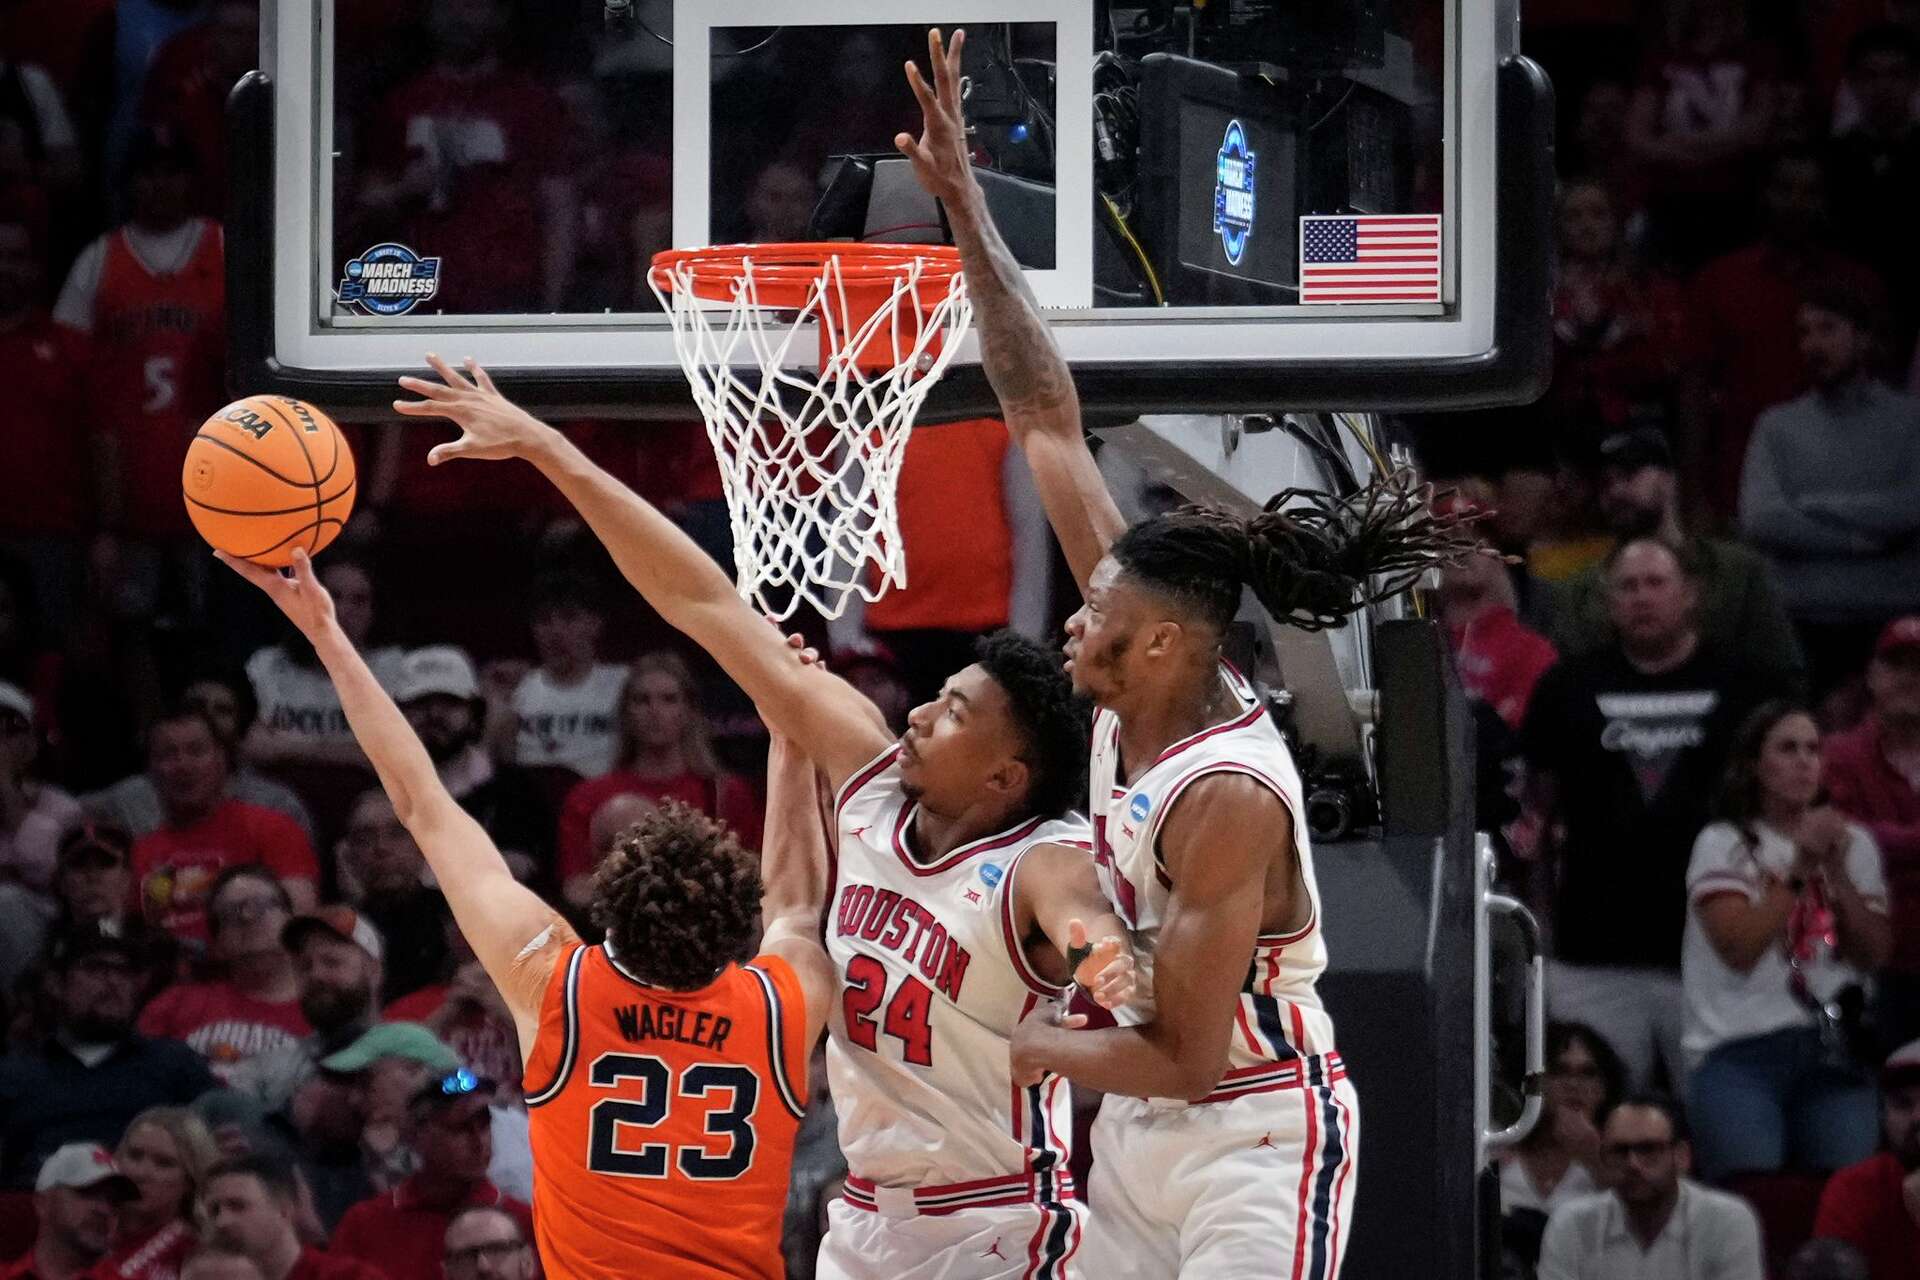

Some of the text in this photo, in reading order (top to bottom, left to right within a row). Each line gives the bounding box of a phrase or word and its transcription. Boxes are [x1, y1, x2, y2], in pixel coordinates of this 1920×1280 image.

[361, 263, 413, 278] MARCH
[367, 279, 435, 293] MADNESS
[837, 884, 971, 1004] HOUSTON
[613, 1004, 733, 1052] WAGLER
[842, 953, 933, 1067] 24
[587, 1051, 760, 1181] 23
